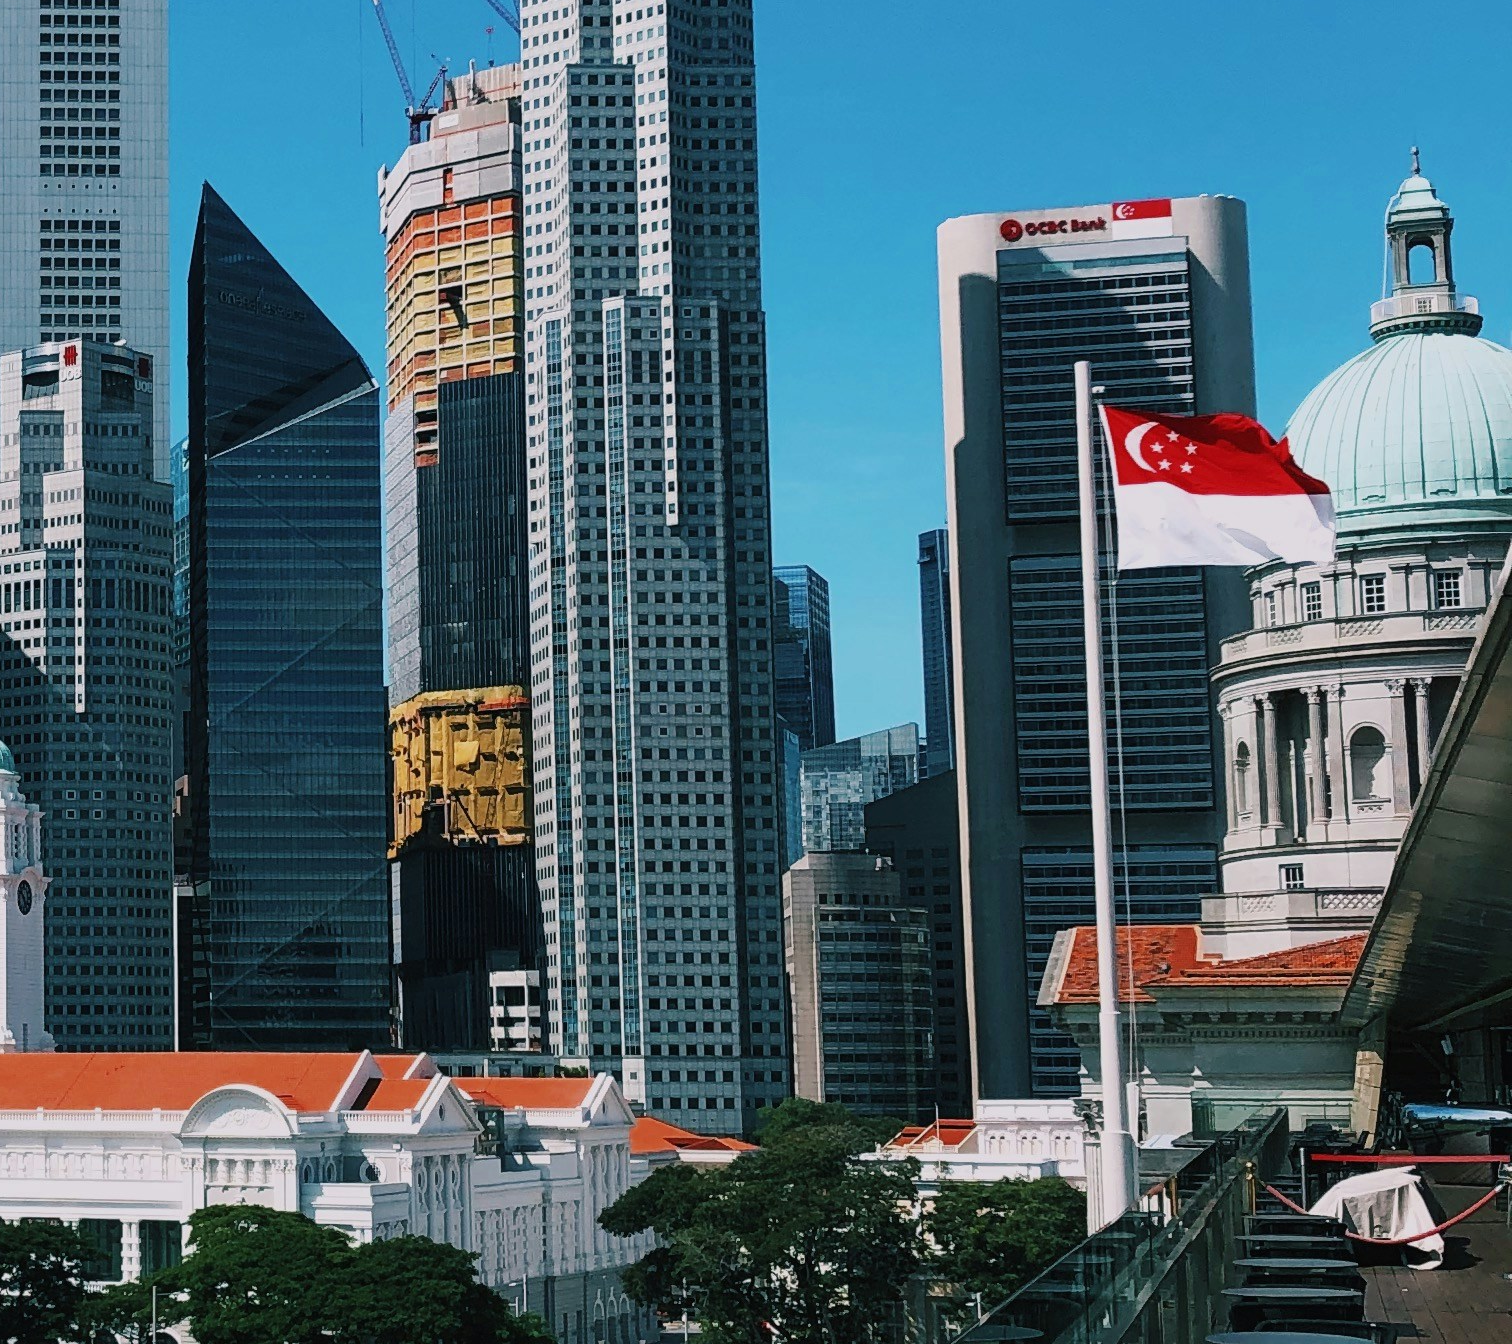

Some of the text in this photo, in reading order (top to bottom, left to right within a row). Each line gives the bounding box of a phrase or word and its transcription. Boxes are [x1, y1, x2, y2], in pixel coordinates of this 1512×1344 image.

[1025, 216, 1107, 236] OCBC Bank
[60, 368, 83, 382] UOB
[134, 379, 153, 394] UOB
